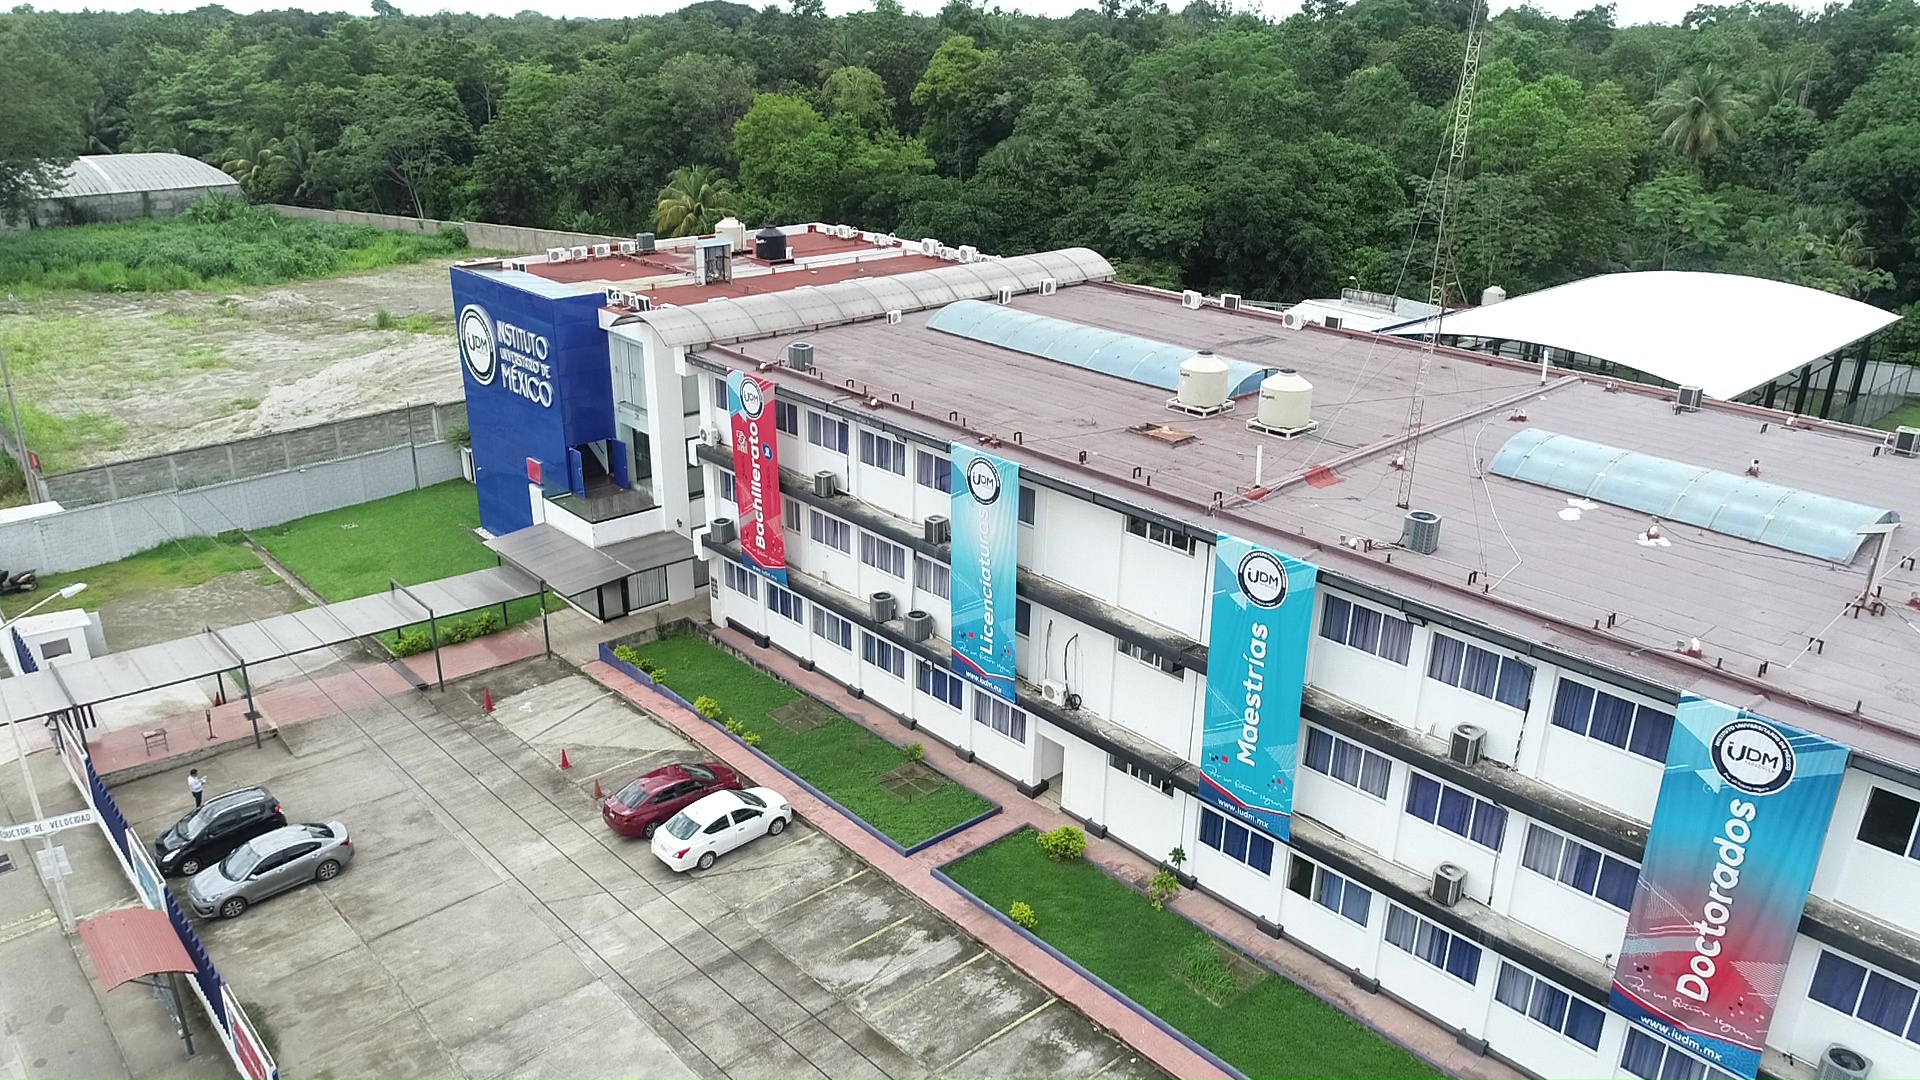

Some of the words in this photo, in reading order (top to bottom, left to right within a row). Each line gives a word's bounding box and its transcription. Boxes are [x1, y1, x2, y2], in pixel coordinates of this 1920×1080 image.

[497, 320, 550, 360] INSTITUTO
[501, 363, 554, 408] MÉXICO
[540, 363, 551, 379] DE
[749, 421, 767, 550] Bachillerato
[979, 508, 995, 656] Licenciaturas
[1236, 622, 1269, 767] Maestrías
[34, 824, 44, 832] DE
[49, 813, 91, 829] VELOCIDAD
[1217, 798, 1269, 828] www.iudm.mx
[1675, 798, 1757, 1003] Doctorados
[1640, 1015, 1722, 1061] www.iudm.mx
